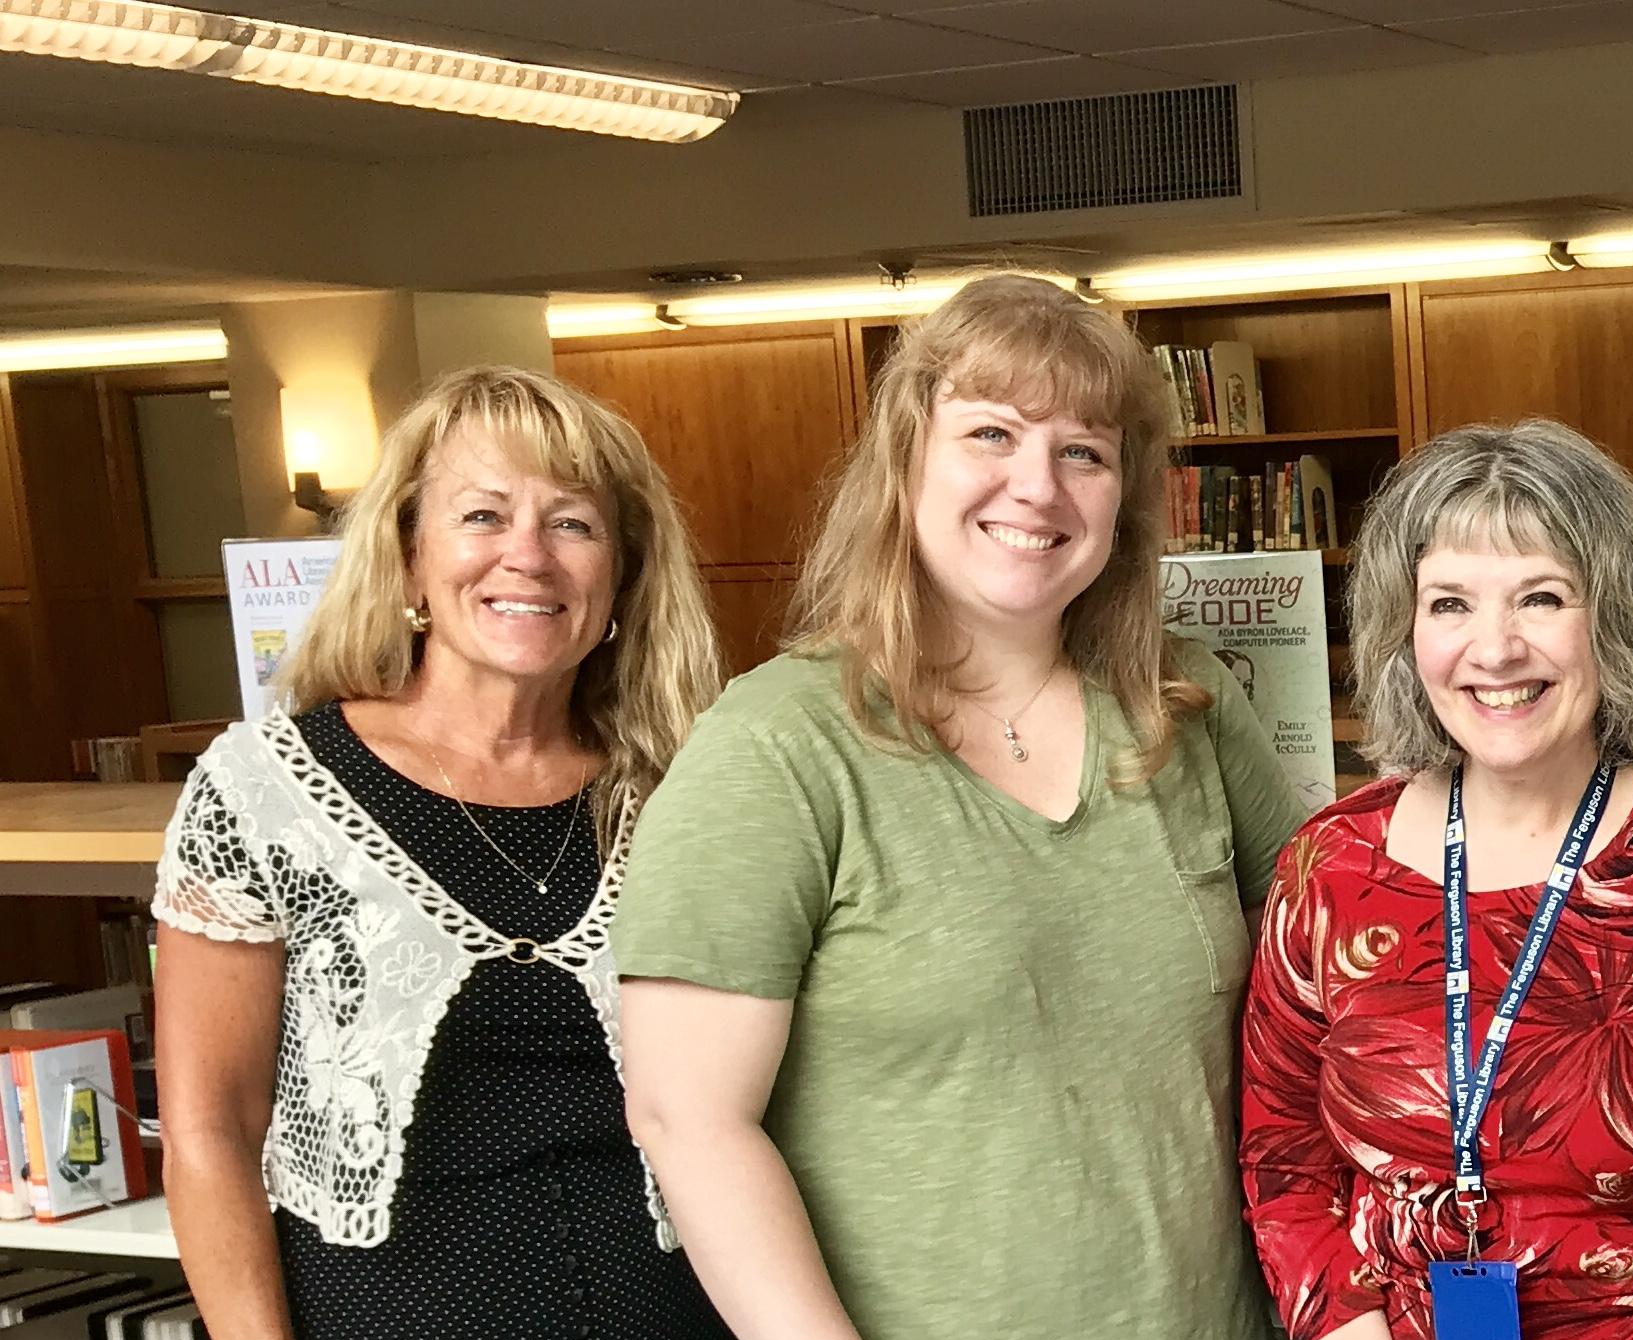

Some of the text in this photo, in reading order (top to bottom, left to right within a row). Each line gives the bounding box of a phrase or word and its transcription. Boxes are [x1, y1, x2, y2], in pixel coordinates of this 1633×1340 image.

[240, 558, 303, 588] ALA
[244, 591, 311, 607] AWARD
[1164, 562, 1304, 608] Dreaming
[1223, 637, 1306, 648] COMPUTER PIONEER
[1561, 841, 1581, 864] The
[1573, 785, 1604, 840] Ferguson
[1450, 845, 1465, 970] The Ferguson Library
[1501, 890, 1564, 1016] The Ferguson Library
[1453, 995, 1465, 1019] The
[1451, 1021, 1466, 1081] Ferguson
[1461, 1042, 1500, 1174] The Ferguson Library
